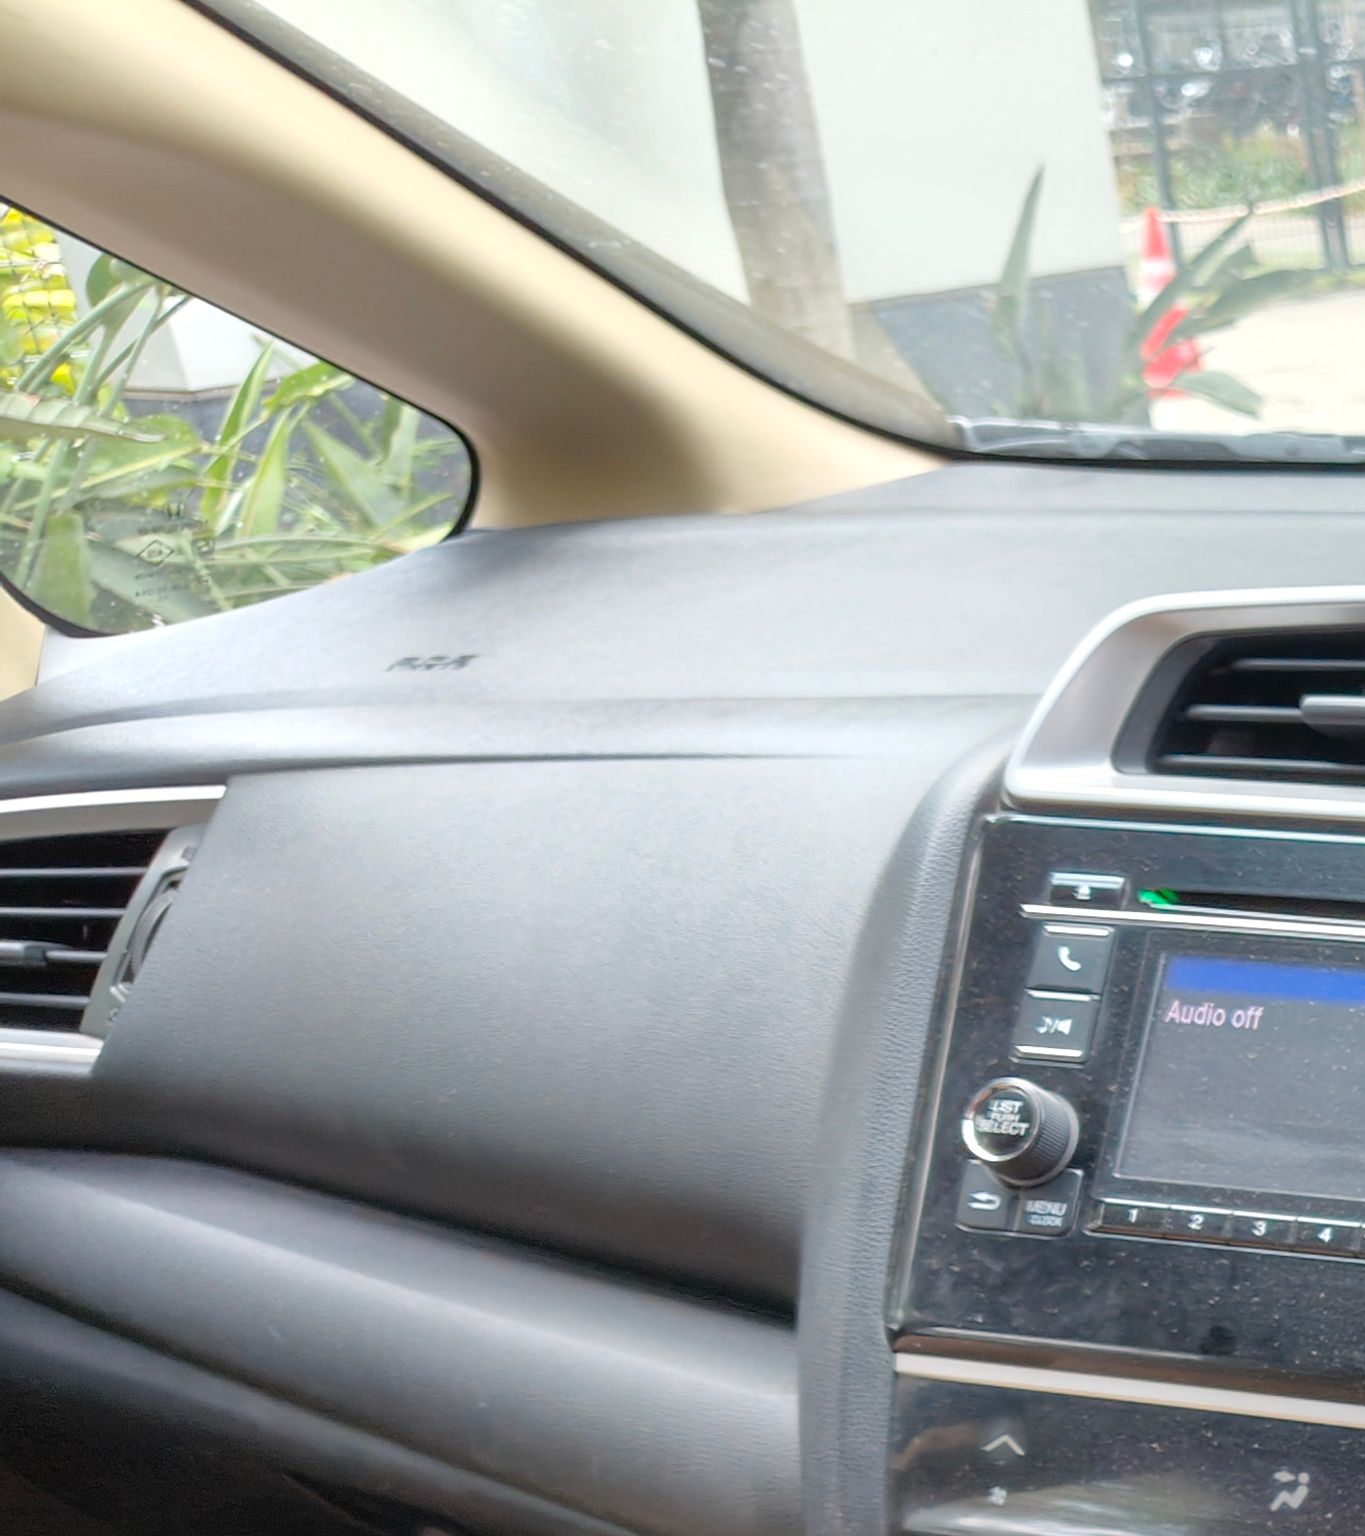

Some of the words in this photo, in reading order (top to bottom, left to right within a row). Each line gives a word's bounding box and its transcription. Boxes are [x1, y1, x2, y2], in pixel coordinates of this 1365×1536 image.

[1165, 1000, 1226, 1027] Audio
[1232, 1006, 1263, 1029] off
[1128, 1208, 1139, 1223] 1
[1188, 1214, 1203, 1230] 2
[1252, 1220, 1266, 1236] 3
[1317, 1227, 1332, 1243] 4
